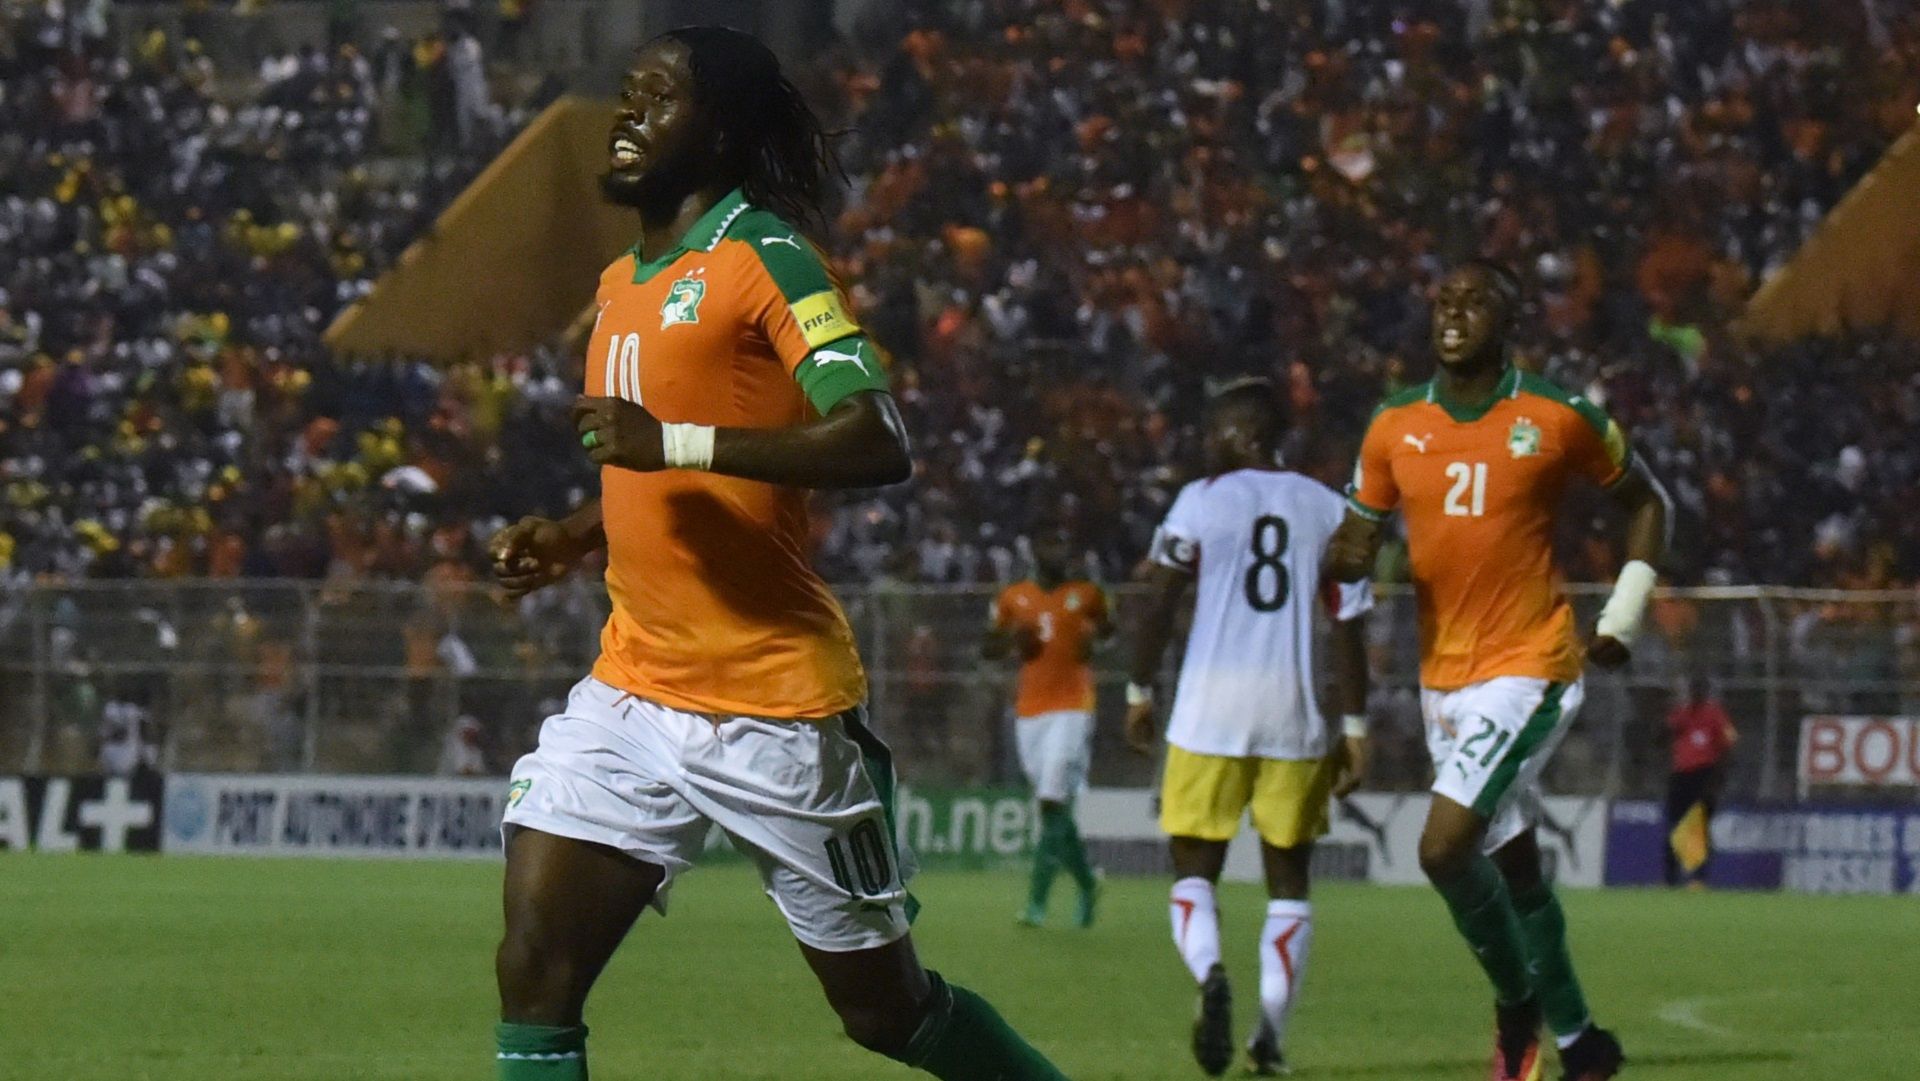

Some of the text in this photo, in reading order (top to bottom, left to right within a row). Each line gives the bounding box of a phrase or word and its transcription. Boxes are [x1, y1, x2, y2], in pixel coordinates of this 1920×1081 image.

[803, 312, 834, 332] FIFA
[606, 333, 644, 407] 10
[1444, 462, 1488, 516] 21
[1245, 514, 1290, 612] 8
[1460, 715, 1510, 767] 21
[823, 818, 890, 897] 10
